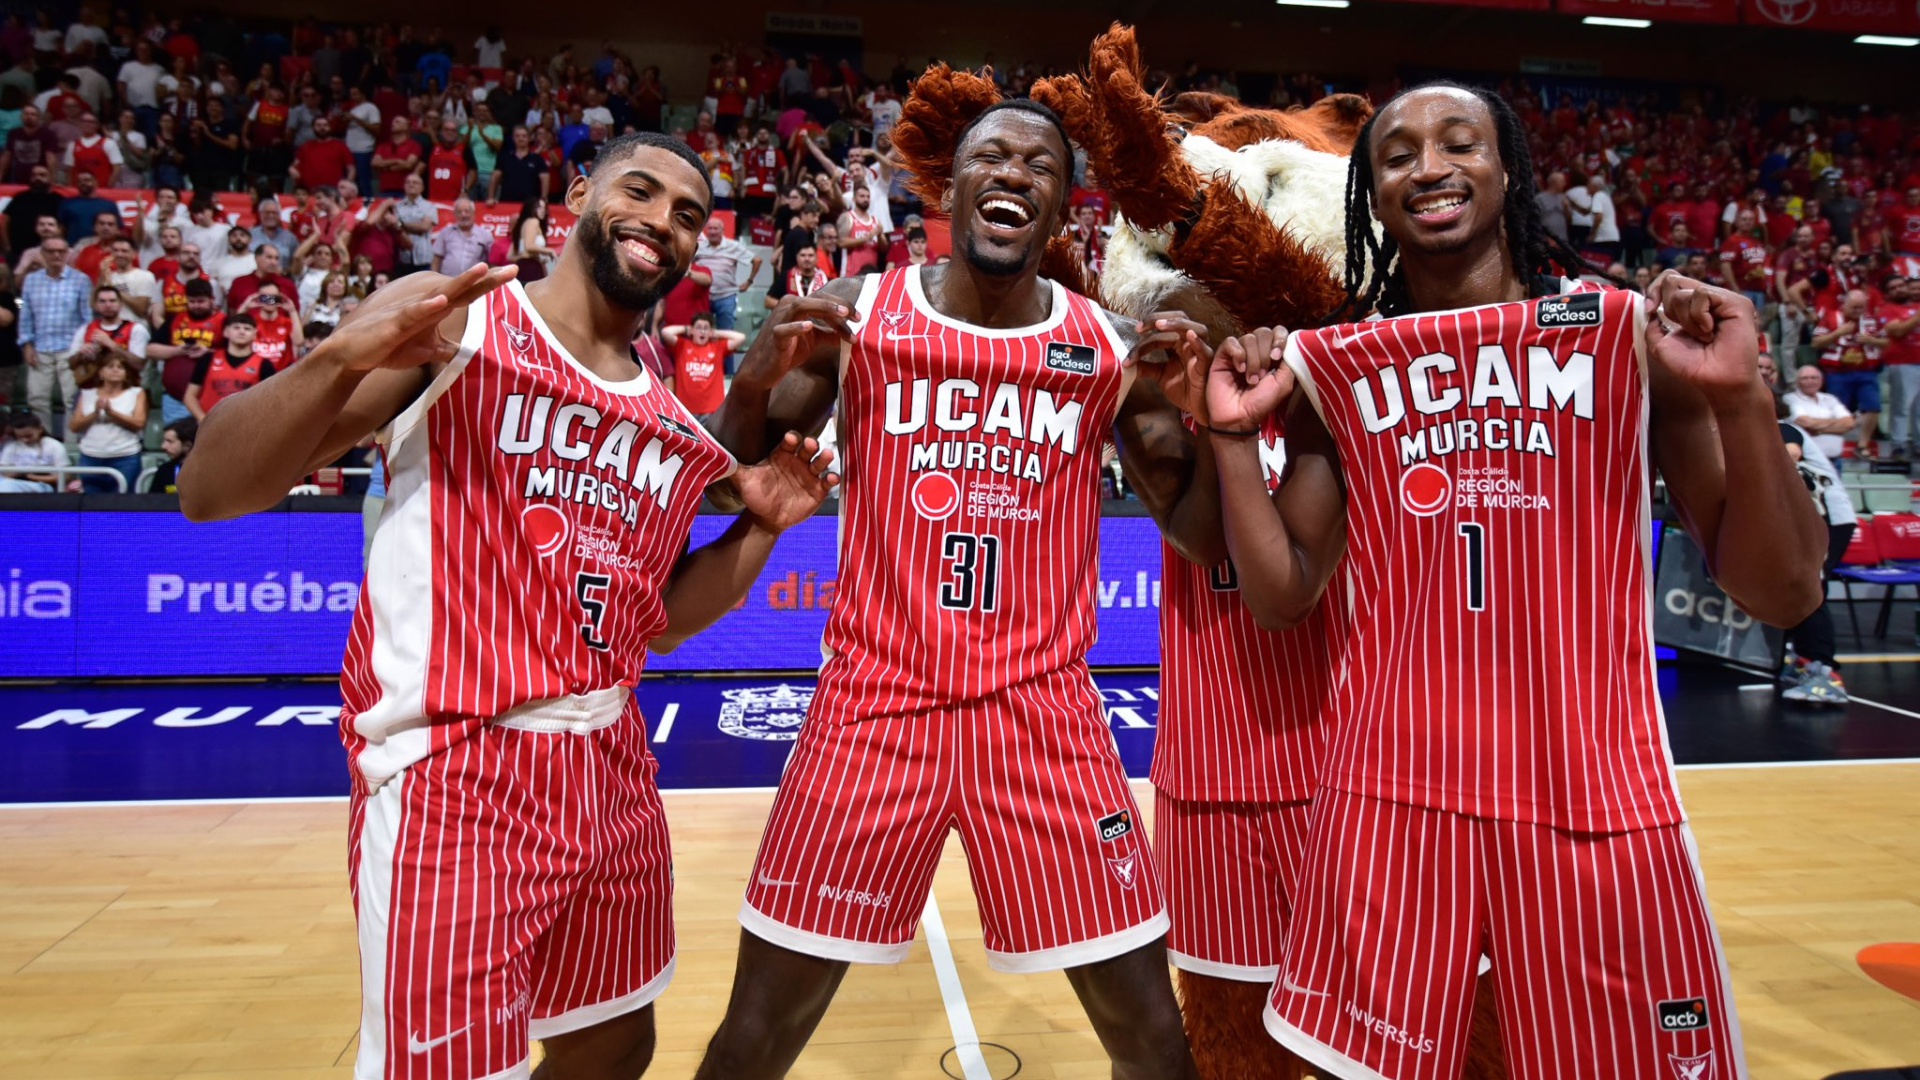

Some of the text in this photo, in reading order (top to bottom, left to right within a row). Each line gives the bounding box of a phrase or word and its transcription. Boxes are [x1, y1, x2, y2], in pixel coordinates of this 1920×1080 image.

[1541, 309, 1596, 323] endesa
[1542, 300, 1567, 312] liga
[1050, 347, 1070, 360] liga
[1050, 358, 1092, 371] endesa
[1351, 344, 1595, 435] UCAM
[883, 377, 1083, 456] UCAM
[497, 393, 684, 512] UCAM
[1400, 417, 1555, 466] MURCIA
[911, 441, 1043, 483] MURCIA
[1458, 466, 1509, 476] Costa Cálida
[969, 481, 1012, 491] Costa Cálida
[1456, 476, 1522, 493] REGIÓN
[524, 466, 638, 532] MURCIA
[968, 486, 1020, 507] REGIÓN
[1456, 494, 1551, 510] DE MURCIA
[967, 504, 1040, 521] DE MURCIA
[574, 545, 594, 560] DE
[940, 532, 1000, 613] 31
[1458, 521, 1485, 611] 1
[0, 568, 71, 618] ia
[575, 570, 611, 653] 5
[1665, 588, 1752, 630] acb
[1103, 822, 1126, 838] acb
[817, 883, 892, 908] INVERSUS
[1345, 1000, 1434, 1053] INVERSUS
[1664, 1011, 1698, 1027] acb
